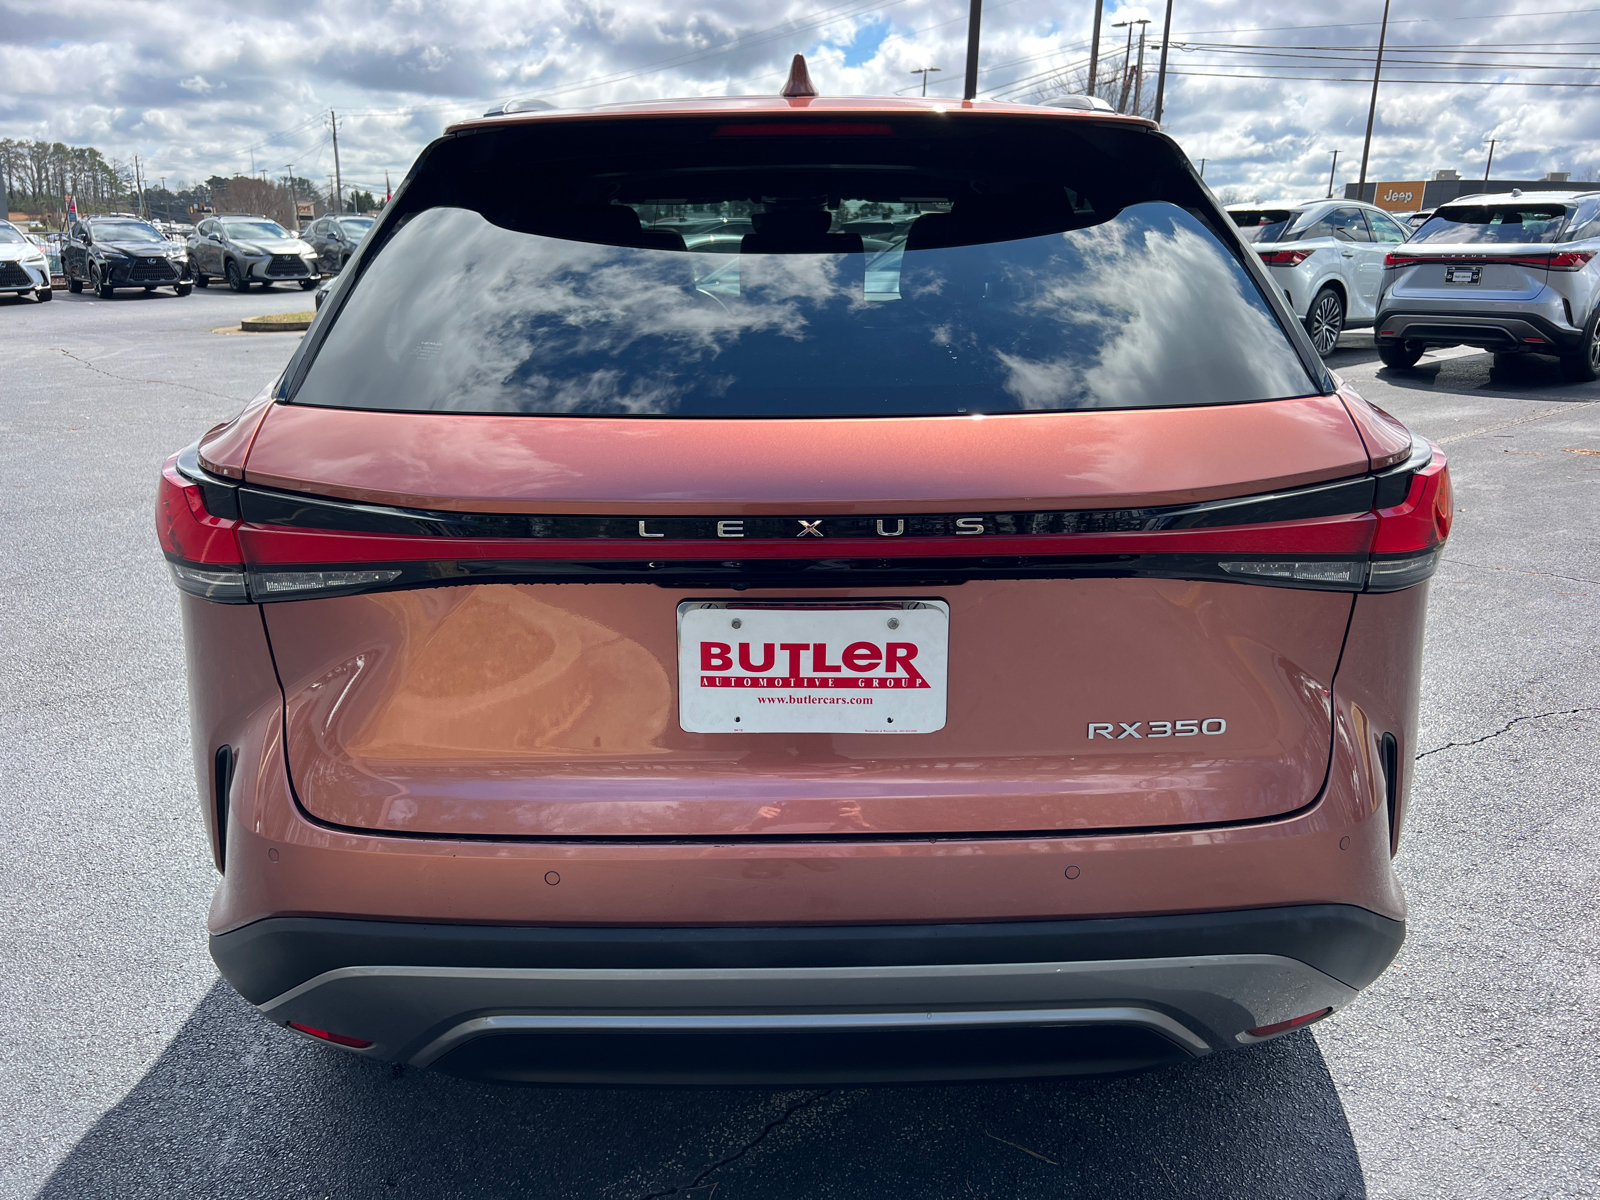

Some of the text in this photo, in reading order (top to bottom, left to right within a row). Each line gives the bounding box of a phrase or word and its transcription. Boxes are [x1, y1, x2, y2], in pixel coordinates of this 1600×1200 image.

[1384, 189, 1413, 203] Jeep
[638, 517, 985, 538] LEXUS
[701, 678, 923, 688] AUTOMOTIVE GROUP
[757, 695, 873, 705] www.butlercars.com
